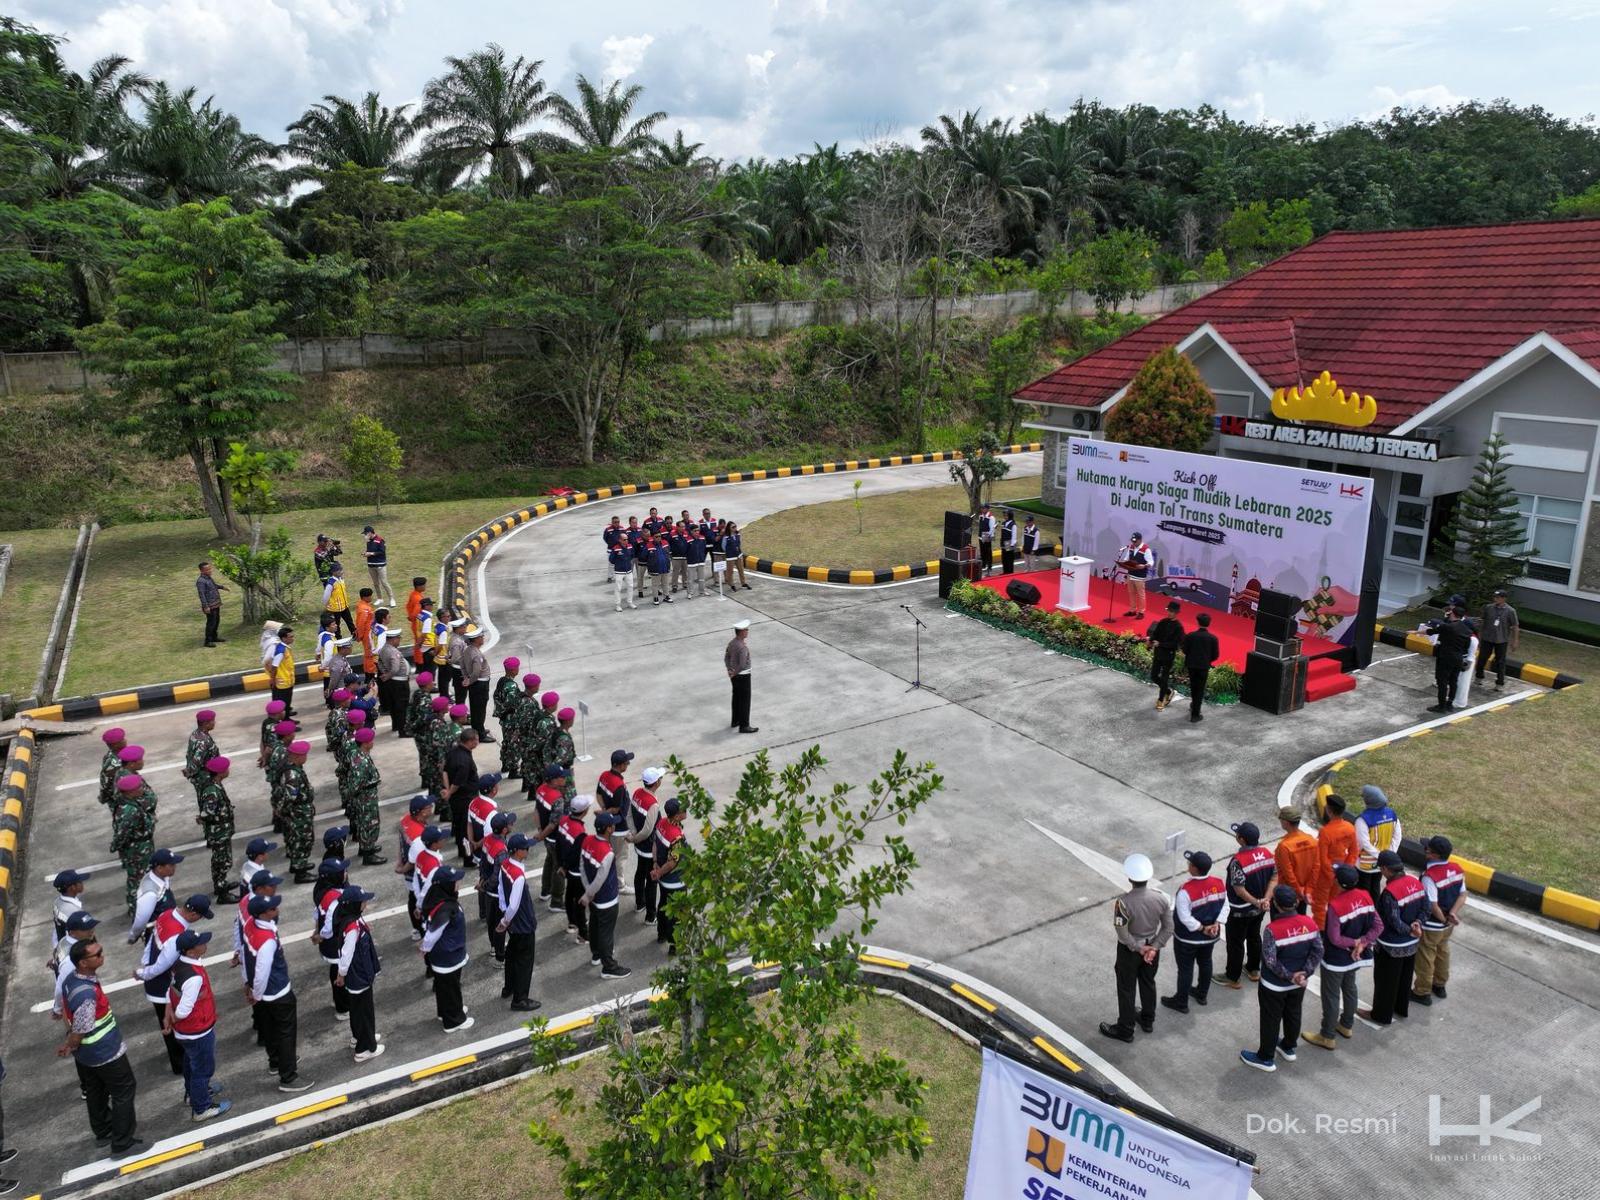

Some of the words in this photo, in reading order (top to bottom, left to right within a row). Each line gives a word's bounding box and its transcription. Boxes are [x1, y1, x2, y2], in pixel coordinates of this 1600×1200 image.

[1245, 422, 1274, 439] REST
[1274, 426, 1305, 444] AREA
[1339, 433, 1375, 453] RUAS
[1376, 437, 1437, 461] TERPEKA
[1077, 468, 1116, 487] Hutama
[1120, 475, 1153, 496] Karya
[1157, 481, 1188, 502] Siaga
[1193, 487, 1231, 507] Mudik
[1235, 495, 1291, 518] Lebaran
[1296, 506, 1333, 526] 2025
[1174, 470, 1196, 484] Kick
[1199, 474, 1217, 491] Off
[1340, 483, 1364, 497] HK
[1111, 493, 1121, 506] Di
[1125, 495, 1154, 513] Jalan
[1160, 501, 1175, 517] Tol
[1180, 505, 1214, 524] Trans
[1218, 512, 1283, 539] Sumatera
[1020, 1082, 1125, 1158] BUMN
[1125, 1153, 1191, 1190] INDONESIA
[1128, 1141, 1170, 1166] UNTUK
[1068, 1153, 1147, 1198] KEMENTERIAN
